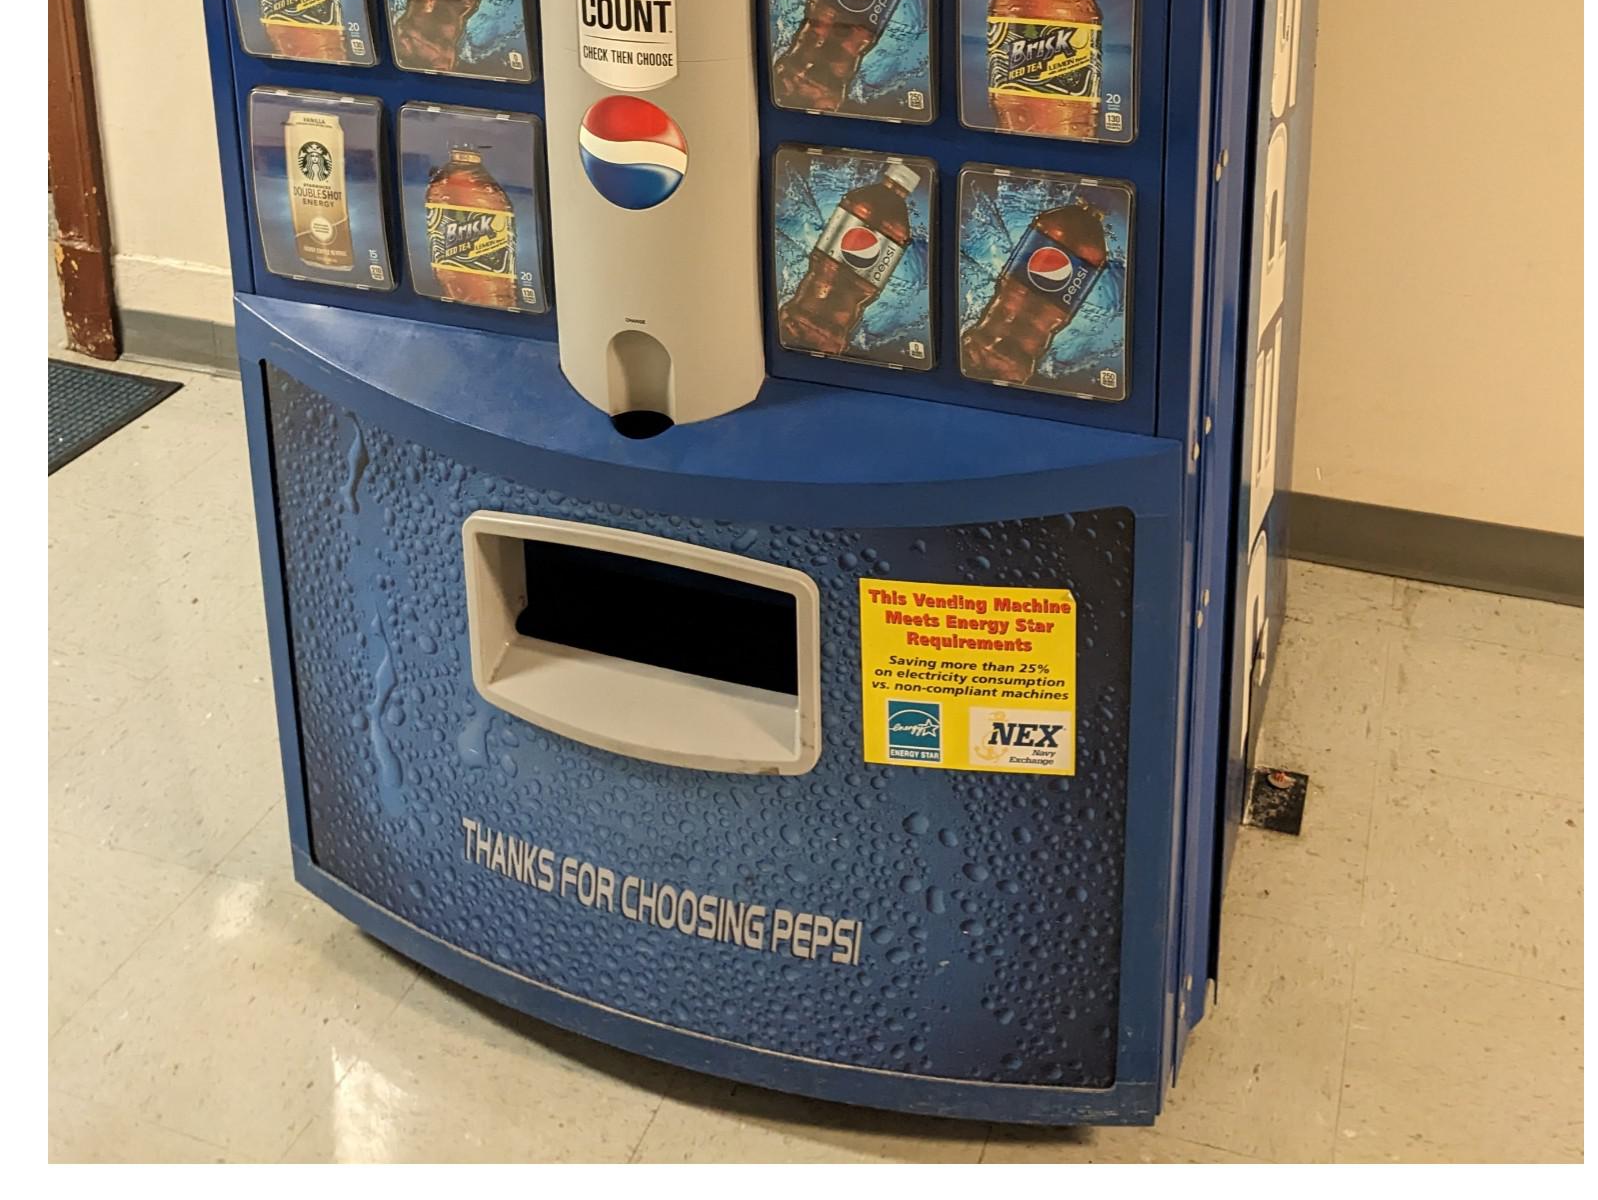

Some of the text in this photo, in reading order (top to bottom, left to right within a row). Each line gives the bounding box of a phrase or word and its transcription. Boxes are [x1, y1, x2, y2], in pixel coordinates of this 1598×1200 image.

[348, 22, 360, 32] 20
[583, 45, 673, 67] CHECK THEN CHOOSE
[1010, 29, 1074, 67] Brisk
[1009, 61, 1042, 80] ICED TEA
[1048, 58, 1075, 71] LEMON
[1105, 94, 1121, 104] 20
[303, 117, 326, 125] VANILLA
[293, 186, 342, 201] DOUBLESHOT
[303, 199, 335, 208] ENERGY
[368, 249, 378, 259] 15
[873, 244, 897, 283] pepsi
[521, 272, 533, 281] 20
[1062, 266, 1089, 305] pepsi
[868, 589, 1072, 614] This Vending Machine
[885, 611, 1055, 635] Meets Energy Star
[906, 632, 1033, 653] Requirements
[889, 655, 1050, 674] Saving more than 25%
[875, 669, 1066, 688] on electricity consumption
[872, 681, 1070, 701] vs. non-compliant machines
[988, 722, 1064, 748] NEX
[890, 749, 940, 760] ENERGY STAR
[1009, 756, 1055, 766] Exchange
[1032, 749, 1056, 758] Navy
[462, 817, 862, 966] THANKS FOR CHOOSING PEPSI
